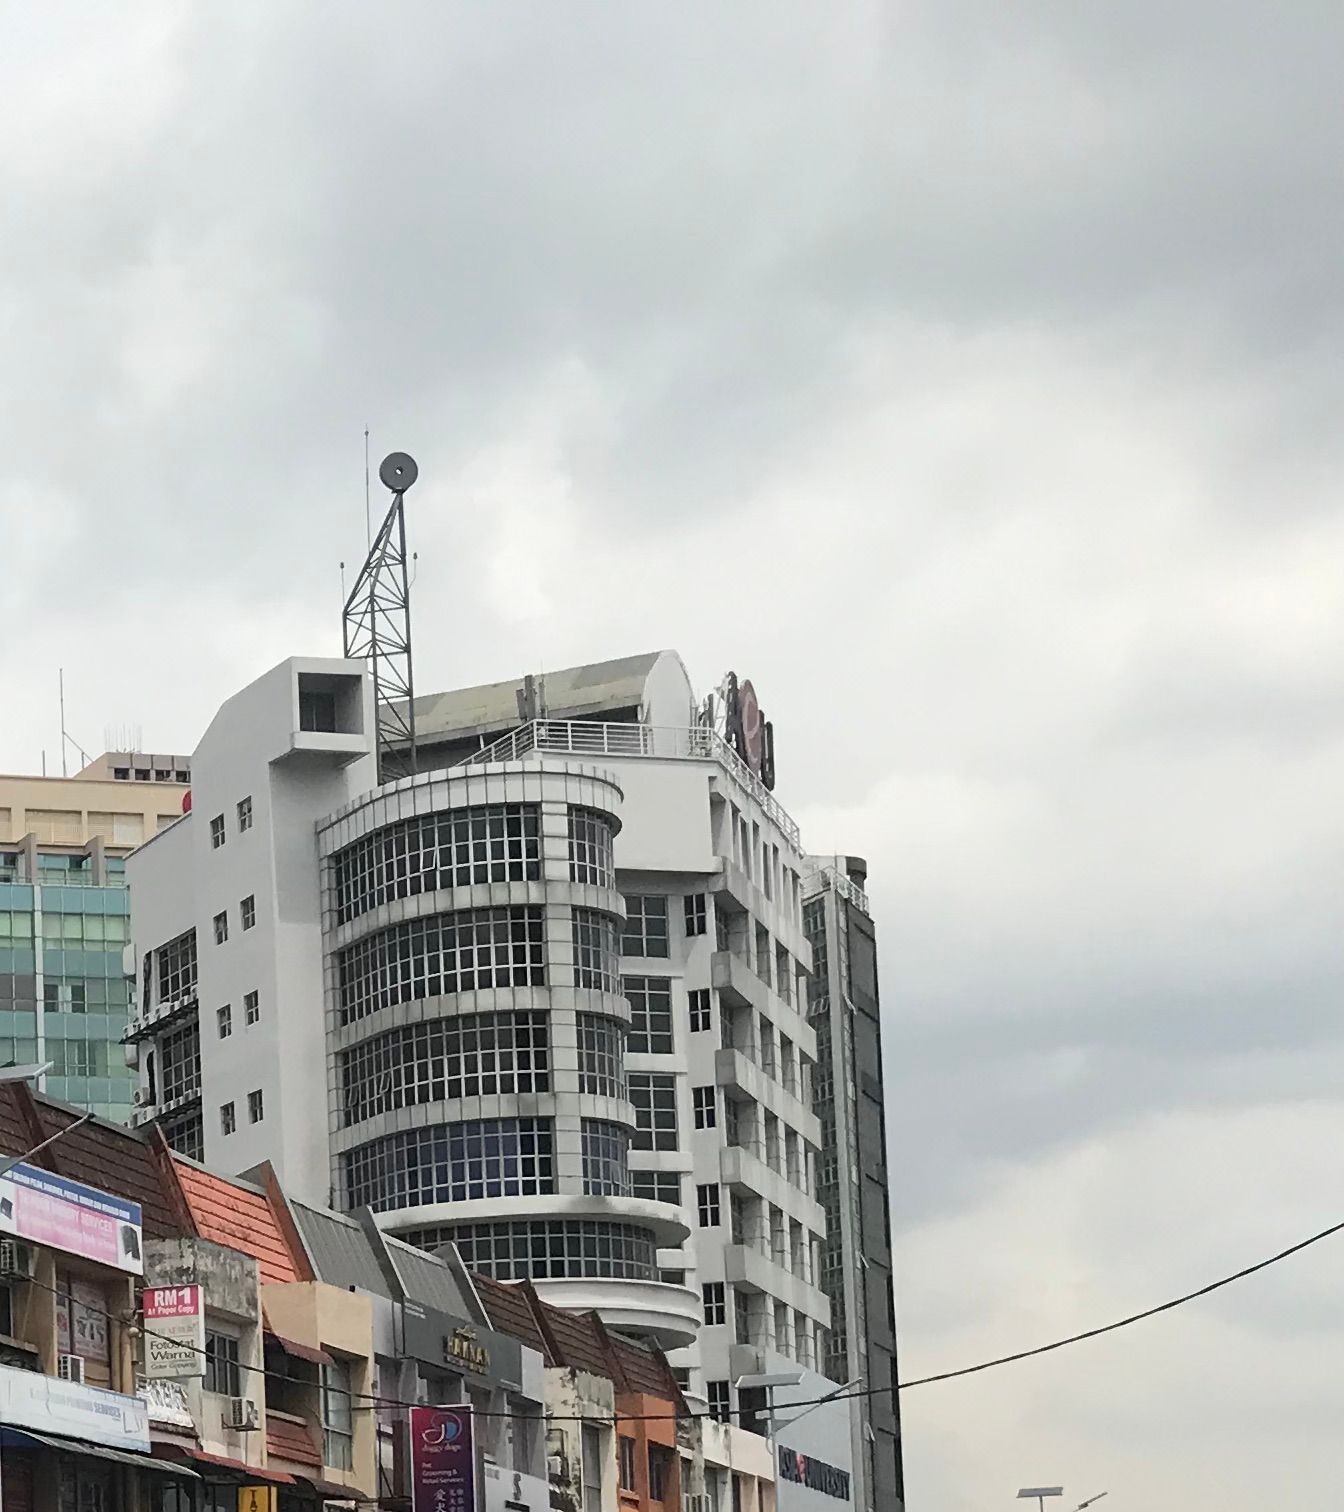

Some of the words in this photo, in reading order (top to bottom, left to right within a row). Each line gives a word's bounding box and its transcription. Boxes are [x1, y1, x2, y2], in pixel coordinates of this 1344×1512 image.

[154, 1286, 191, 1307] RM1
[177, 1304, 195, 1315] Copy
[150, 1350, 195, 1360] Warna
